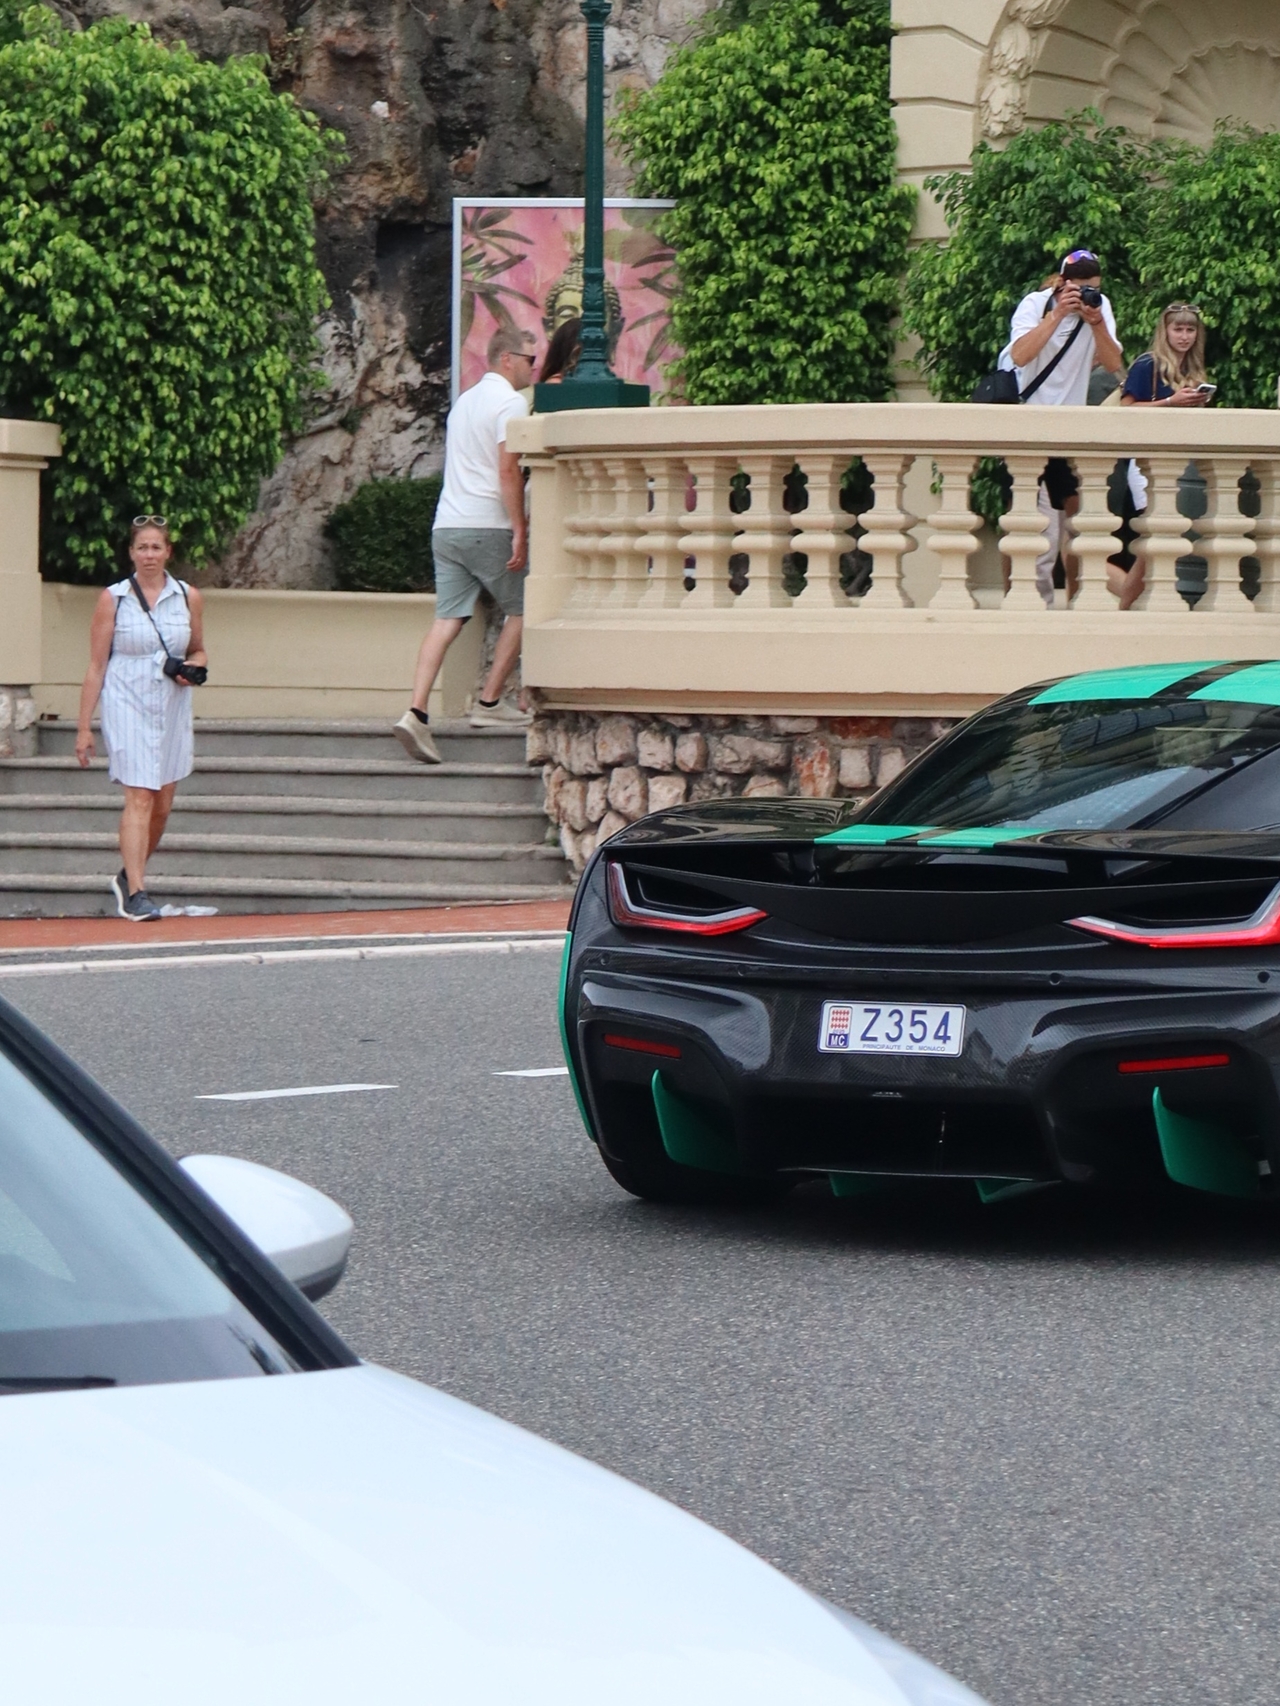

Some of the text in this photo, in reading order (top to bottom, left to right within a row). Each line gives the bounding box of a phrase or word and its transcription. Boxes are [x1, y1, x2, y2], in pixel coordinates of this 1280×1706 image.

[860, 1008, 951, 1044] Z354
[830, 1034, 846, 1047] MC
[862, 1043, 901, 1051] PRINCIPAUTE
